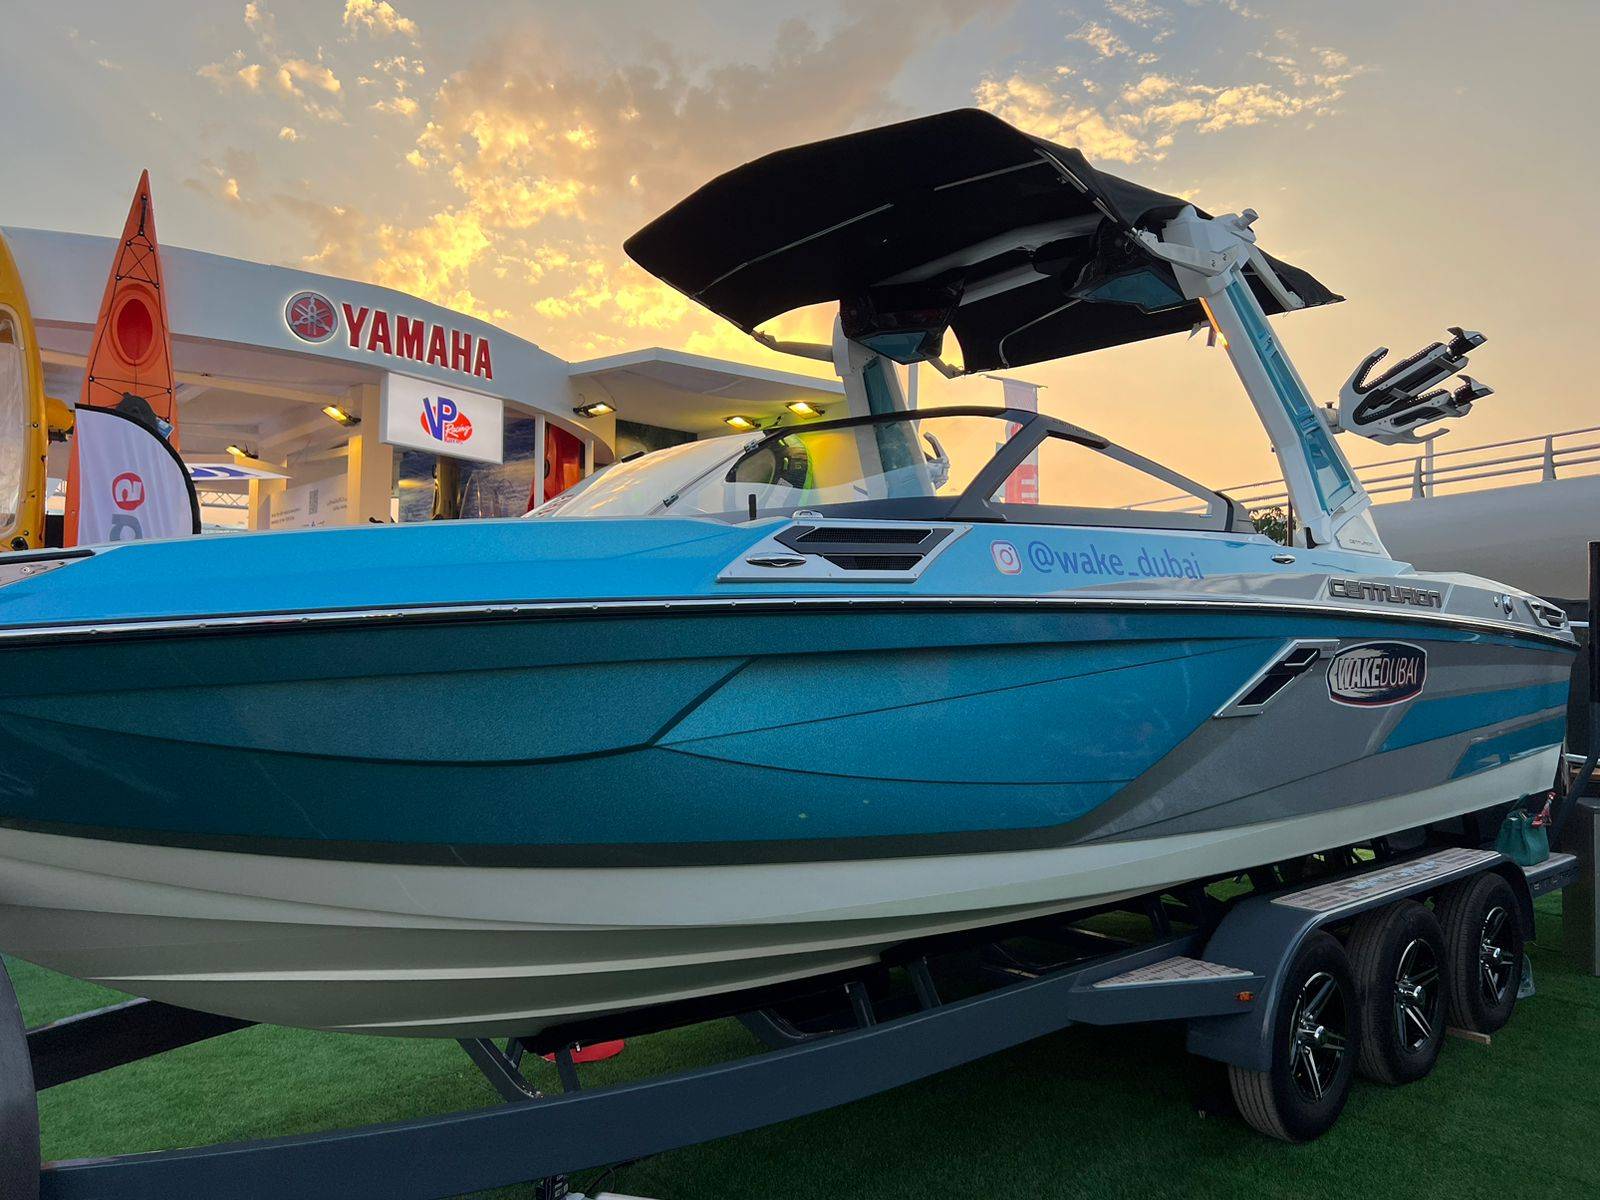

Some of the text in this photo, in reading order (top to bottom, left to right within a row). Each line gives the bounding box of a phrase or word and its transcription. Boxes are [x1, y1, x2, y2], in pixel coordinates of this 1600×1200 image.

[342, 302, 493, 380] YAMAHA
[422, 396, 458, 441] VP
[1027, 540, 1205, 580] @wake_dubai
[1328, 578, 1442, 608] CENTURION
